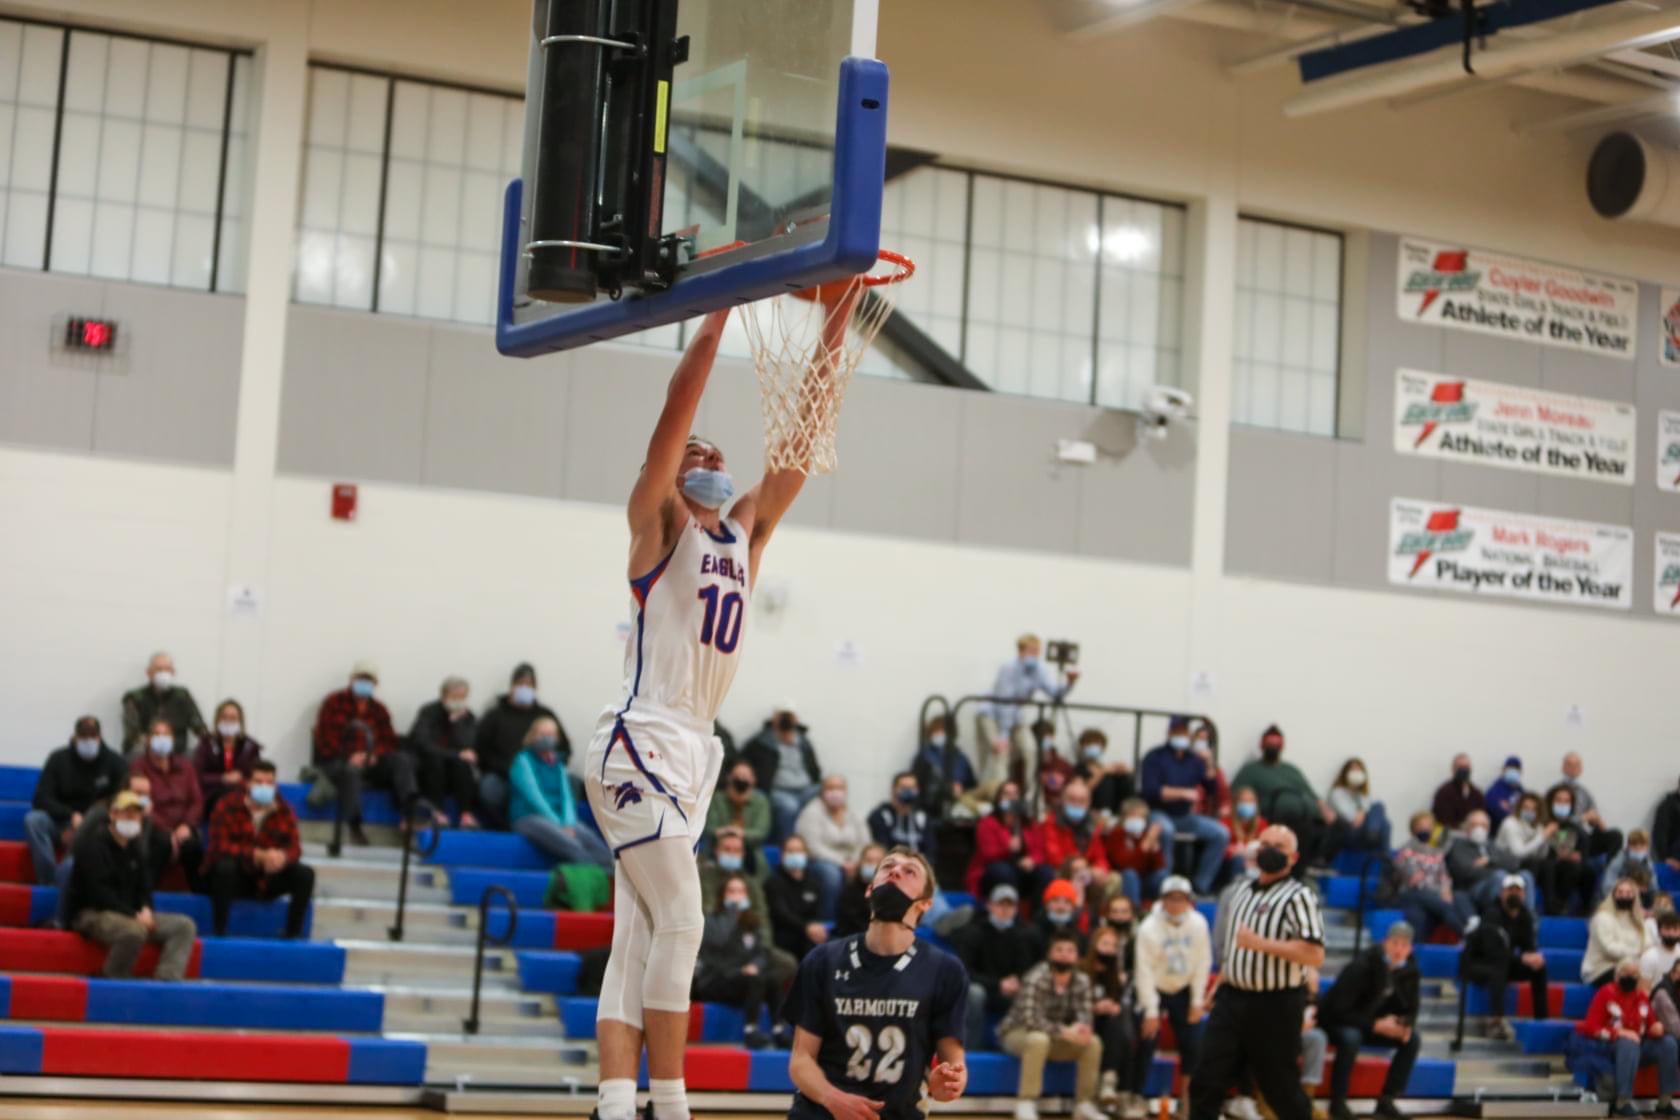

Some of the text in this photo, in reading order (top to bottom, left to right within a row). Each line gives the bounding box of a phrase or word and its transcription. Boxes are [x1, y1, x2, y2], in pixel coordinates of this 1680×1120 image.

[1441, 299, 1629, 350] Athlete of the Year
[1440, 431, 1627, 476] Athlete of the Year
[1436, 559, 1622, 599] Player of the Year
[697, 583, 744, 655] 10
[834, 998, 920, 1018] YARMOUTH
[845, 1024, 906, 1084] 22
